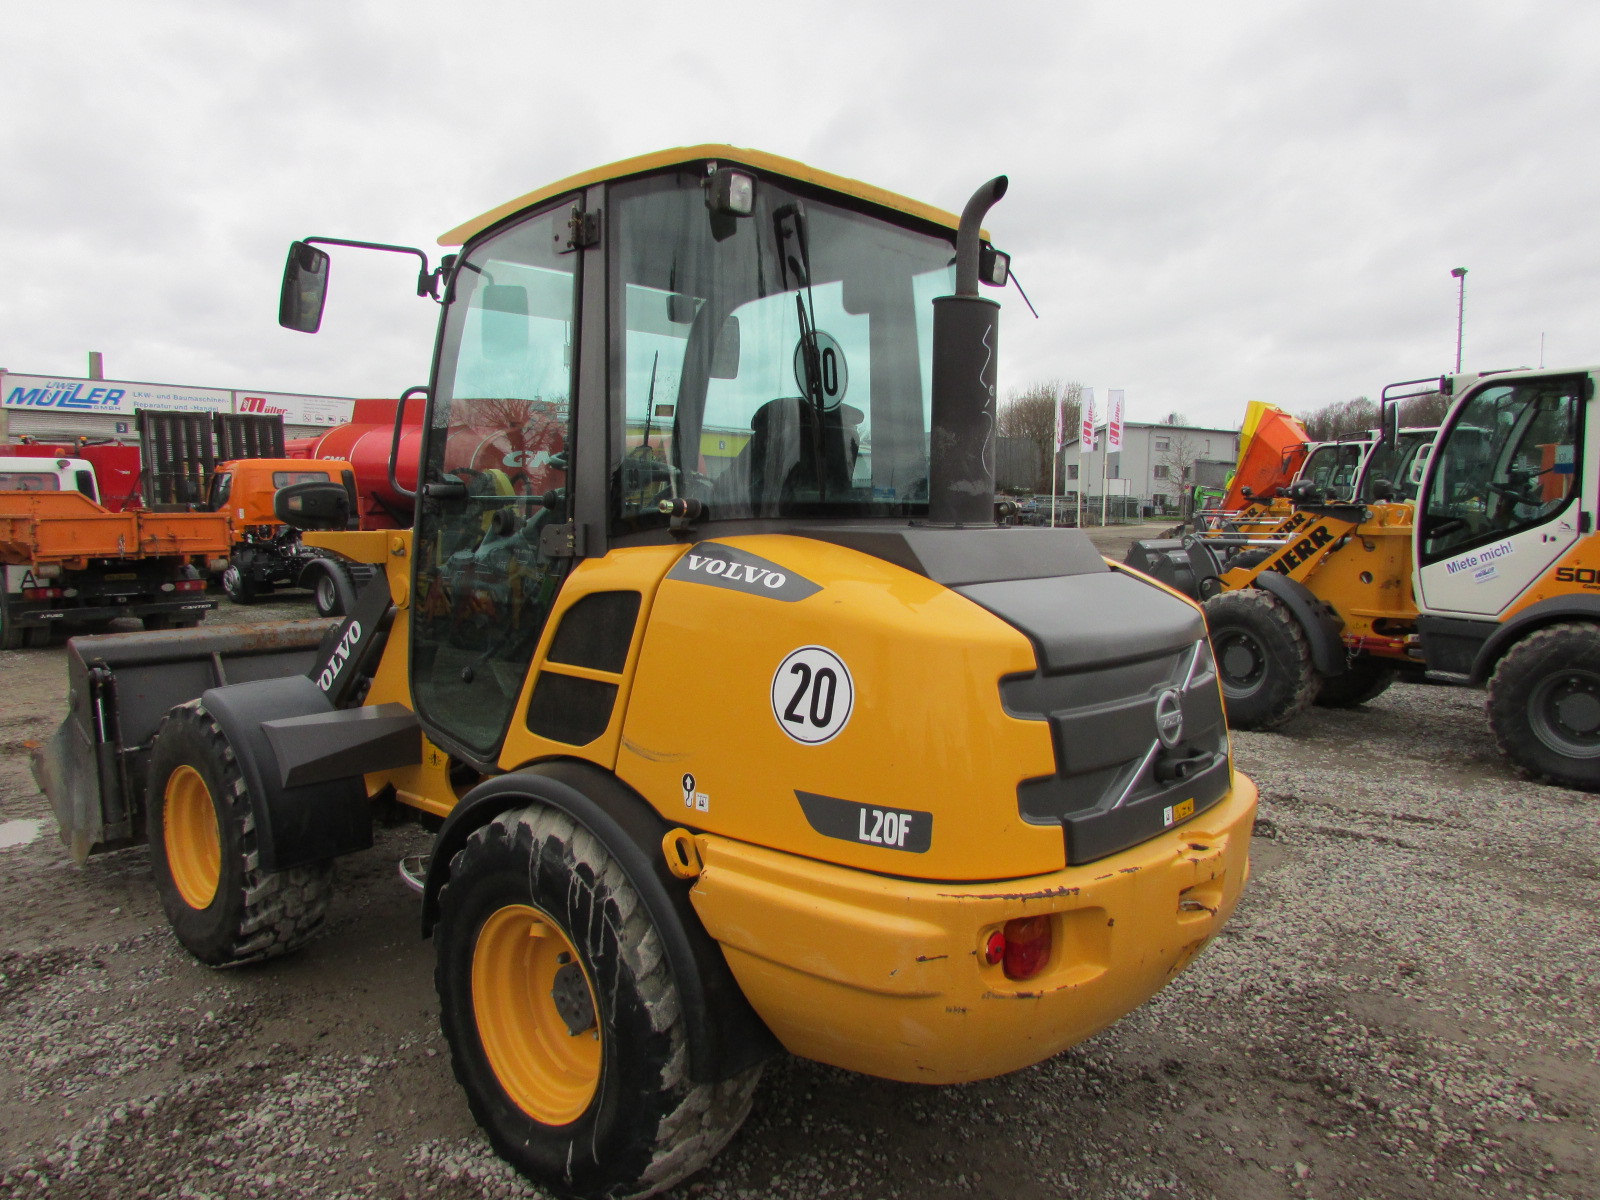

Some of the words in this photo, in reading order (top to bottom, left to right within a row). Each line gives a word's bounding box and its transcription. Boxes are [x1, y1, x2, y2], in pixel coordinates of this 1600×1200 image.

[688, 554, 787, 589] VOLVO
[1446, 558, 1478, 574] Miete
[1480, 541, 1513, 563] mich!
[784, 662, 837, 728] 20
[859, 807, 912, 847] L20F
